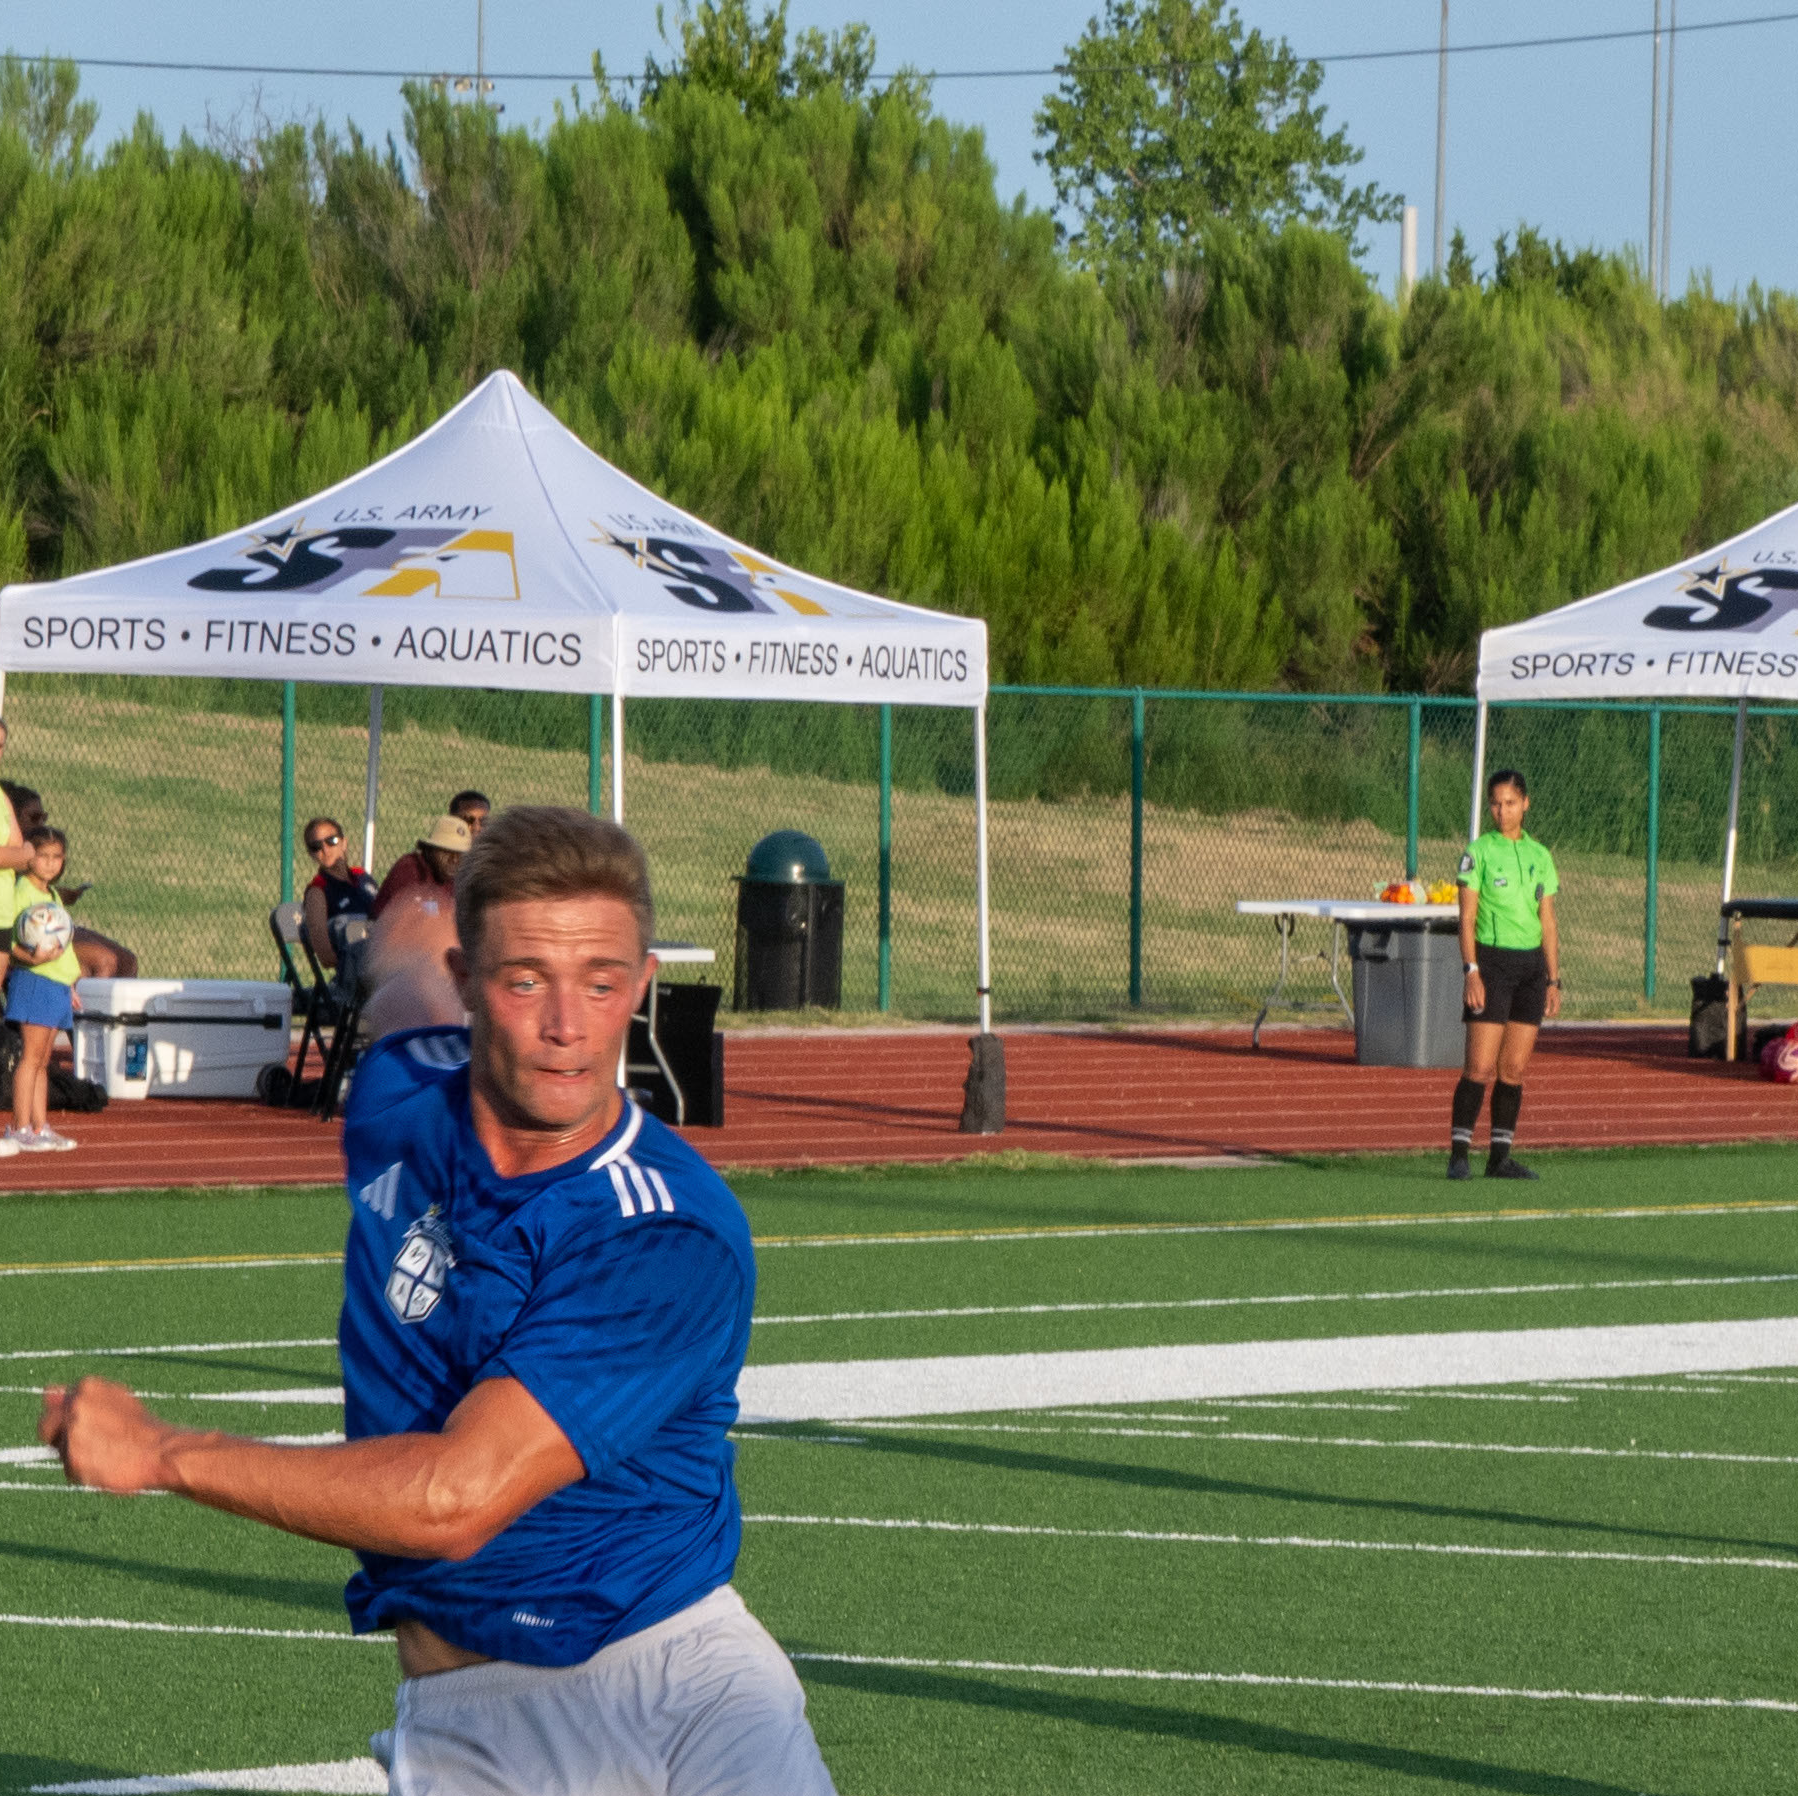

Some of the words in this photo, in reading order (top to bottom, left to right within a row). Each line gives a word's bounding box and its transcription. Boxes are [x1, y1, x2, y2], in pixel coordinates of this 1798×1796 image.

[333, 505, 383, 523] U.S.
[394, 504, 493, 521] ARMY
[1751, 550, 1798, 564] U.S.
[23, 615, 167, 651] SPORTS
[204, 619, 356, 657] FITNESS
[393, 626, 582, 667] AQUATICS
[637, 638, 727, 673] SPORTS
[748, 640, 840, 676] FITNESS
[859, 645, 969, 682] AQUATICS
[1510, 651, 1637, 680] SPORTS
